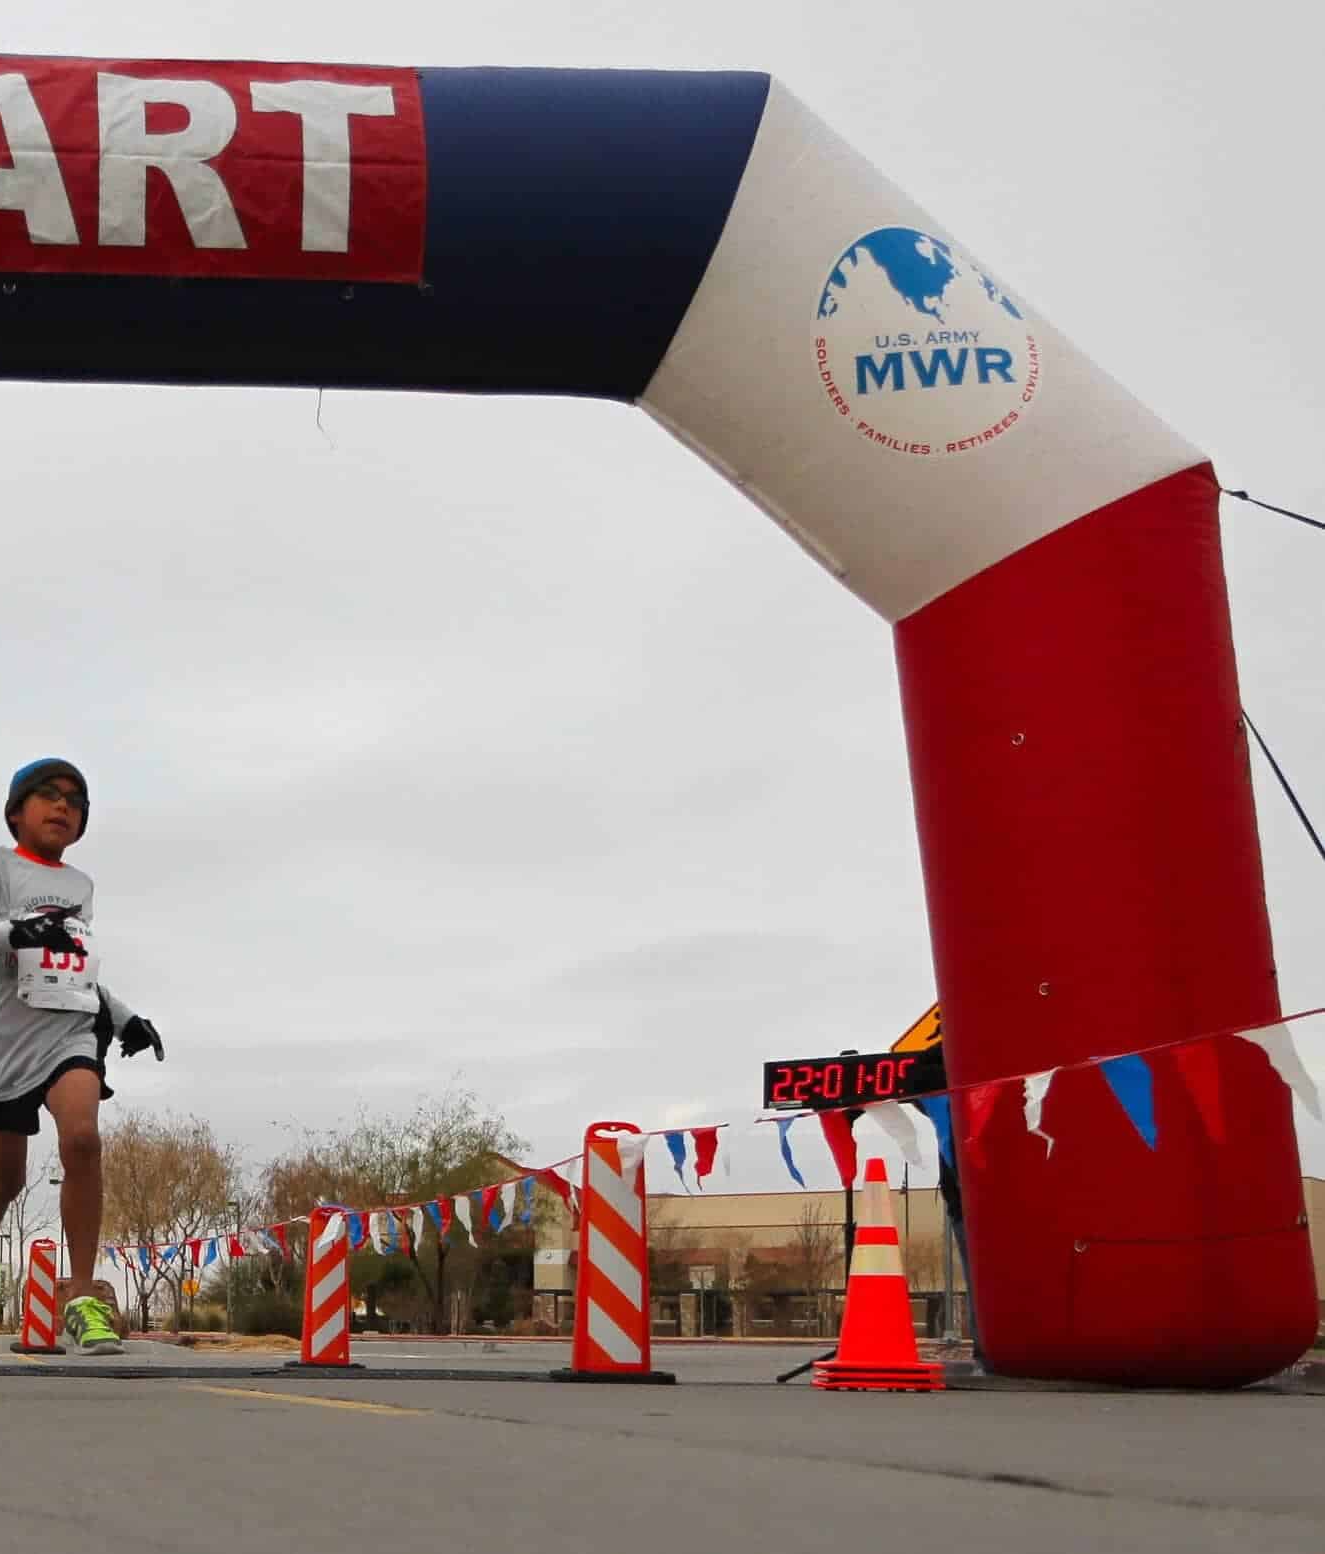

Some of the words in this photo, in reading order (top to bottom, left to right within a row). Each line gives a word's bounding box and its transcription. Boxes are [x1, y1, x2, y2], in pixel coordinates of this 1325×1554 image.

[875, 333, 917, 349] U.S.
[925, 330, 980, 345] ARMY
[855, 347, 1017, 395] MWR
[815, 336, 850, 416] SOLDIERS
[857, 421, 931, 455] FAMILIES
[945, 411, 1019, 453] RETIREES
